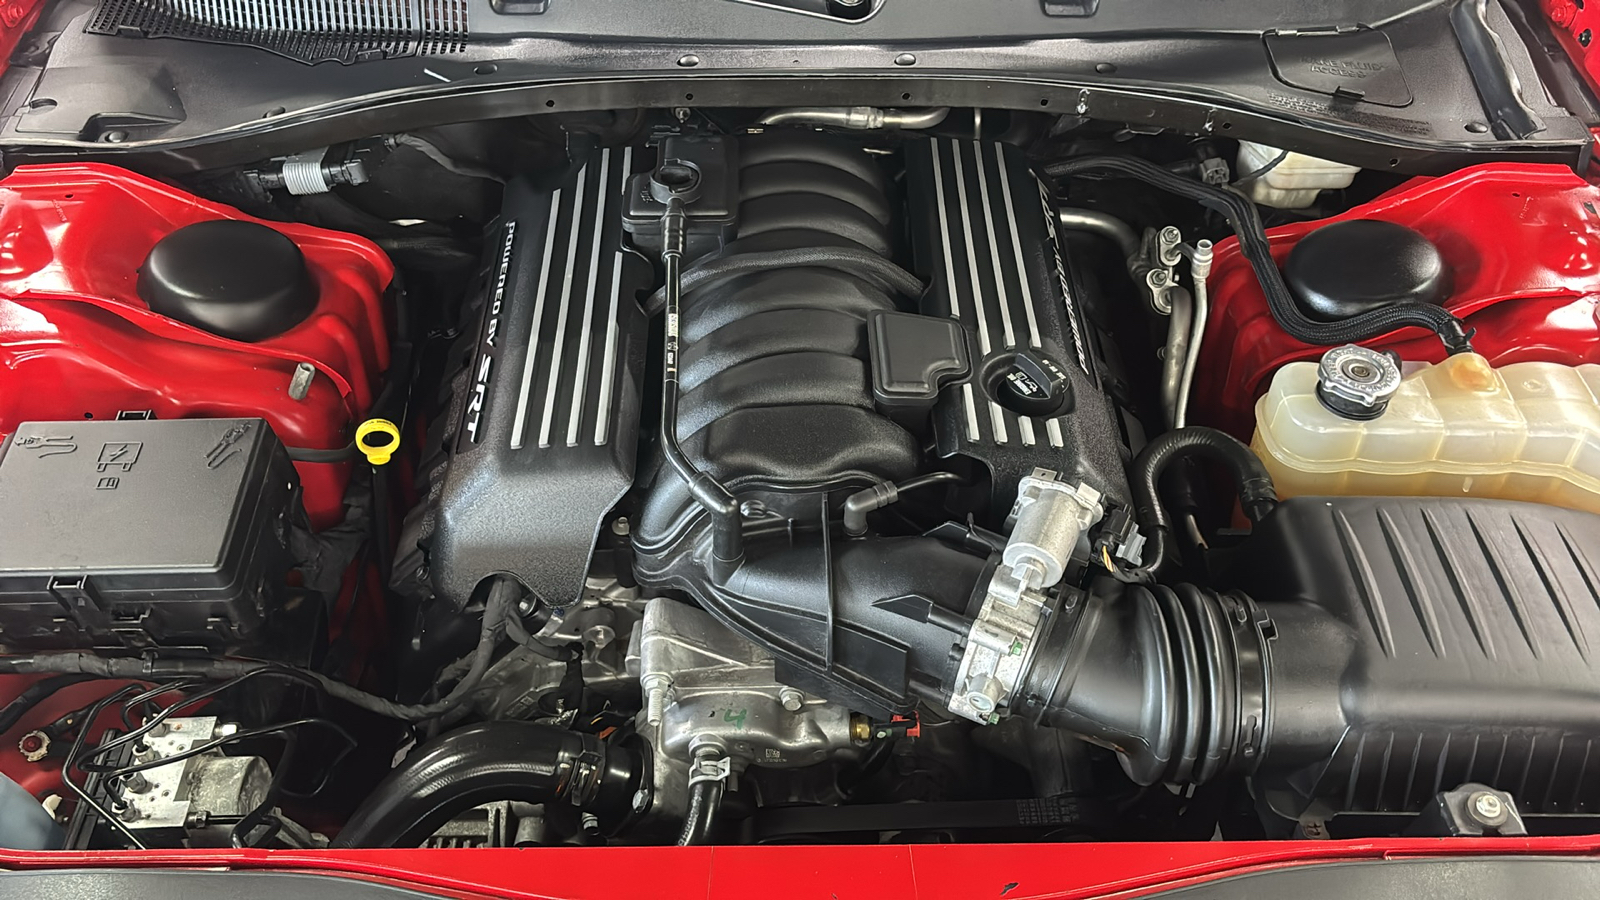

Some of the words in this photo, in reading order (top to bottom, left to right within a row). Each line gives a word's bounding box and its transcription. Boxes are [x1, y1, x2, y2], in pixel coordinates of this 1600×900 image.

[1310, 65, 1367, 79] ACCESS
[493, 221, 516, 315] POWERED
[487, 319, 498, 347] BY
[467, 353, 492, 443] SRT
[723, 708, 747, 730] 4
